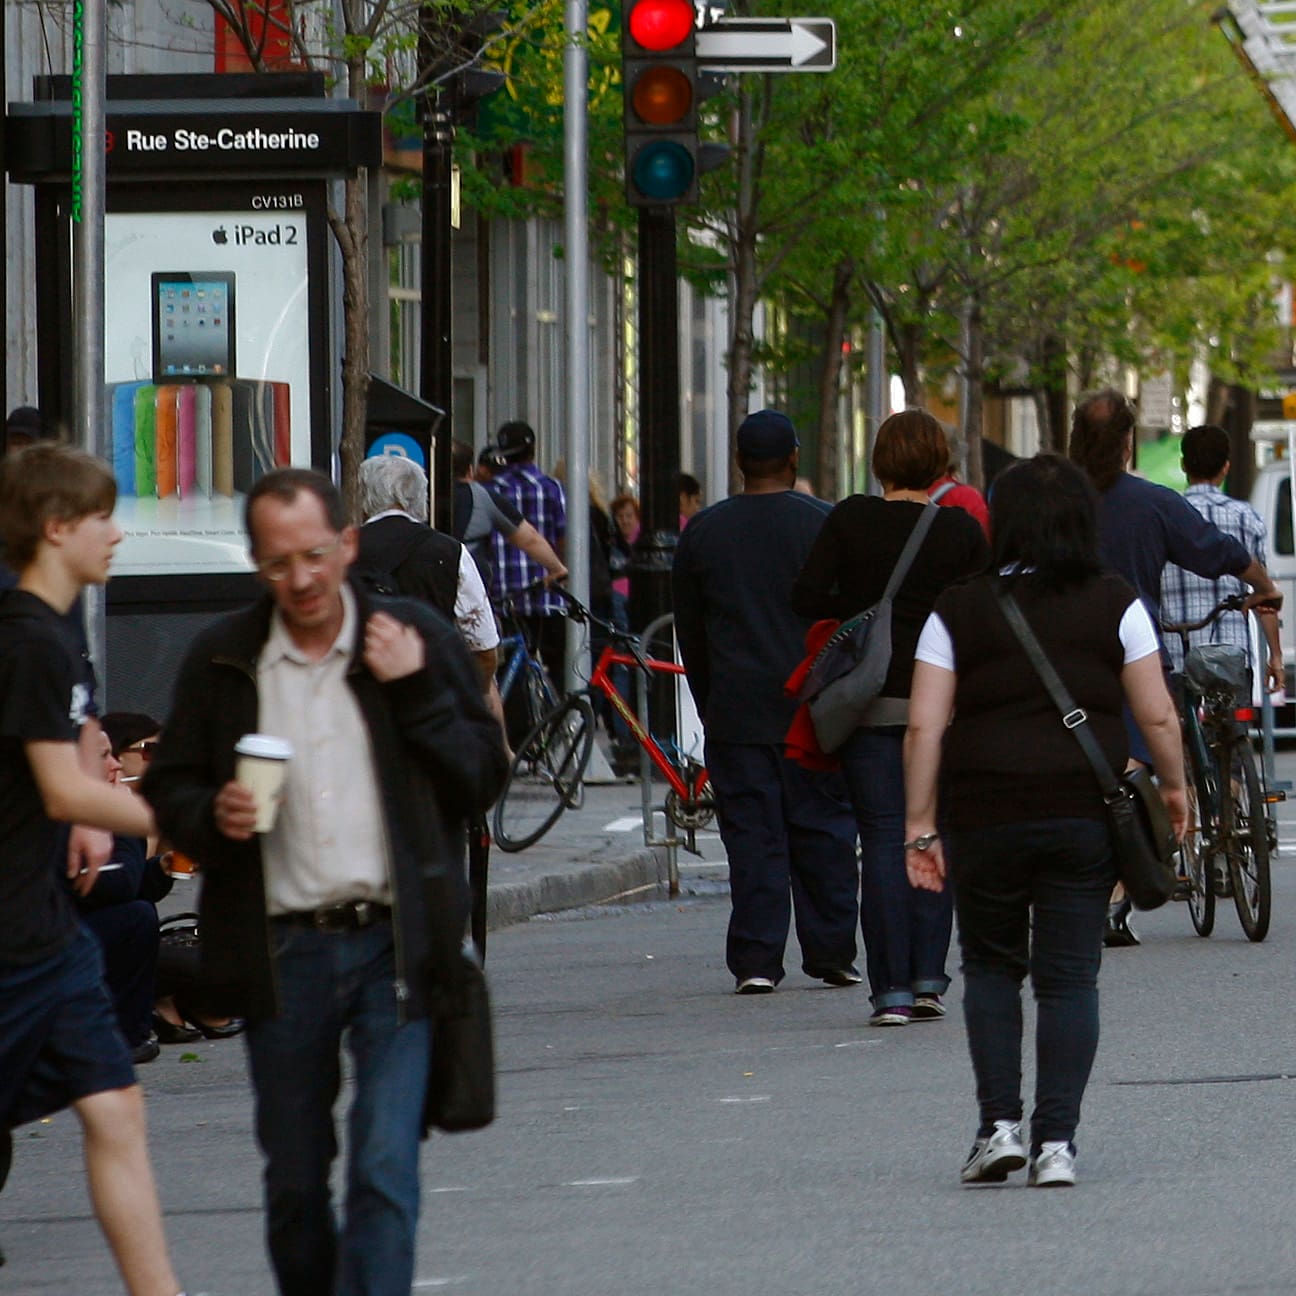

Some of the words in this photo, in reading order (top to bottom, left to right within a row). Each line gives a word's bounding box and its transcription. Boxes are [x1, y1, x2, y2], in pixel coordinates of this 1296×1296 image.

[127, 129, 168, 151] Rue
[174, 128, 319, 151] Ste-Catherine
[251, 194, 304, 210] CV131B
[234, 225, 281, 246] iPad
[285, 225, 298, 245] 2
